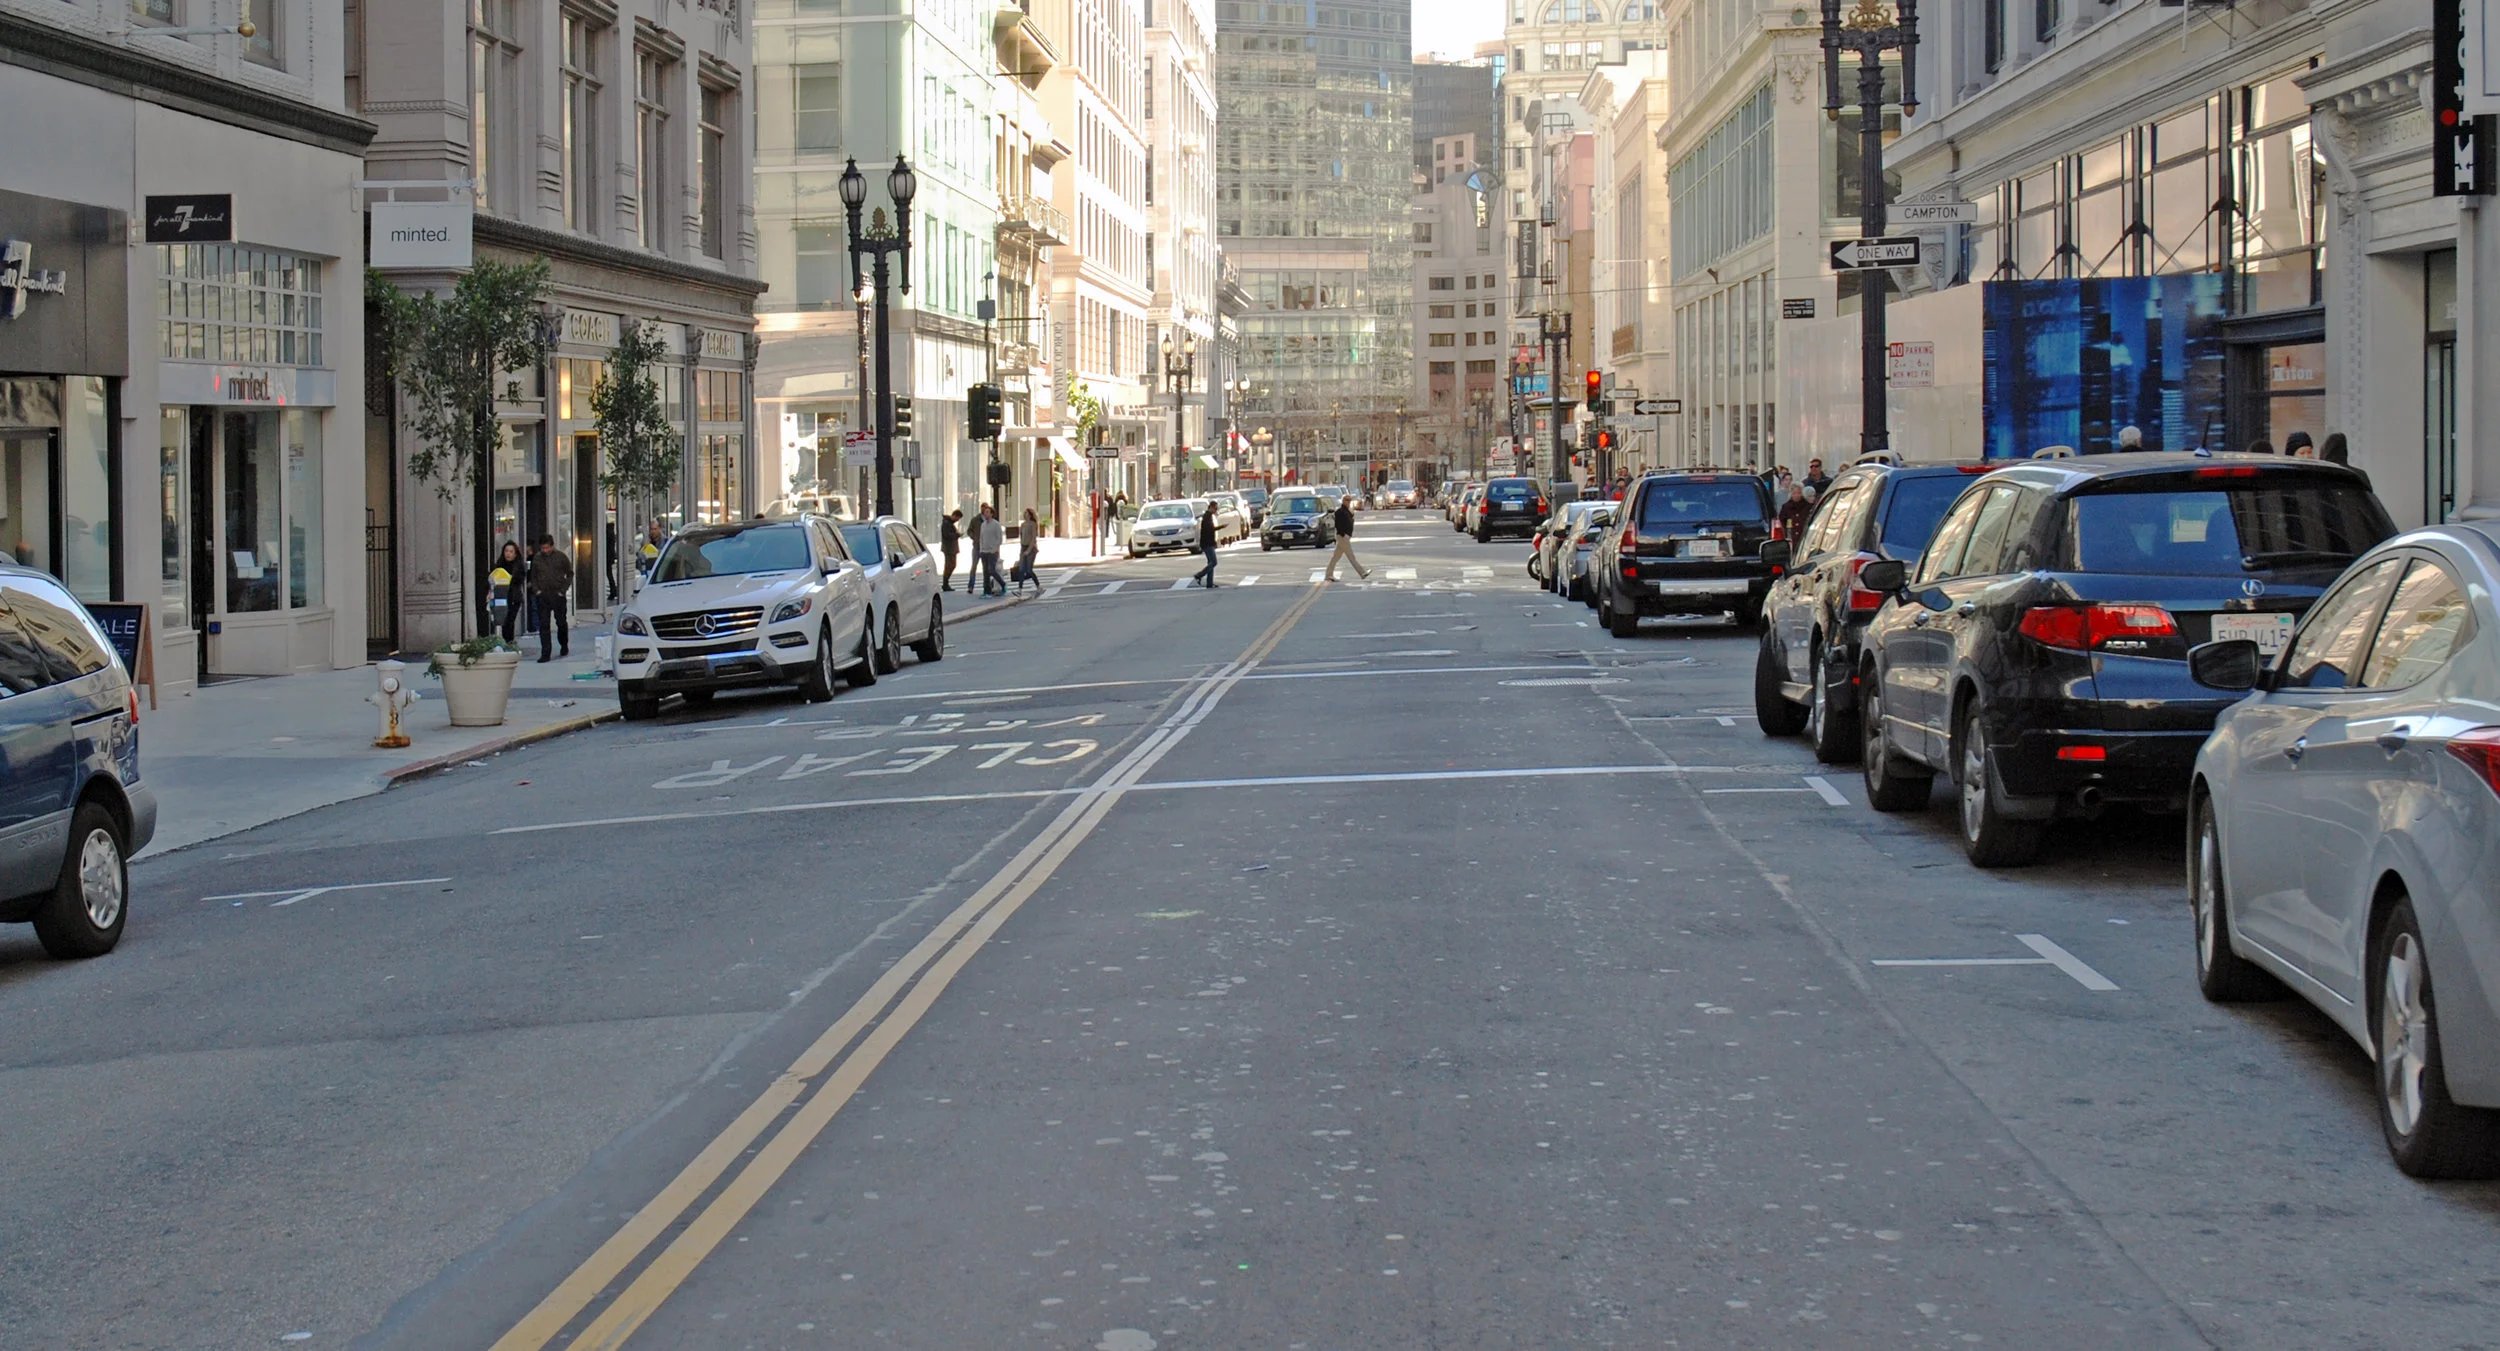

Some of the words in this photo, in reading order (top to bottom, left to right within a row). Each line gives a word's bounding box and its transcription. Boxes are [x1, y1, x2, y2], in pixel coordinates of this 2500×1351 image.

[175, 205, 195, 233] 7
[184, 213, 224, 222] mankind
[1904, 207, 1958, 219] CAMPTON
[391, 226, 451, 242] minted.
[1857, 248, 1881, 259] ONE
[1886, 246, 1910, 257] WAY
[3, 240, 32, 320] 7
[20, 268, 67, 296] mankind
[570, 313, 610, 342] COACH
[706, 332, 736, 355] COACH
[1054, 321, 1063, 361] GIORGIO
[1890, 344, 1903, 356] NO
[1905, 346, 1933, 354] PARKING
[228, 371, 270, 401] minted.
[1054, 367, 1063, 402] ARMANI
[99, 619, 137, 635] ALE
[2104, 640, 2147, 649] ACURA
[652, 739, 1098, 789] CLEAR
